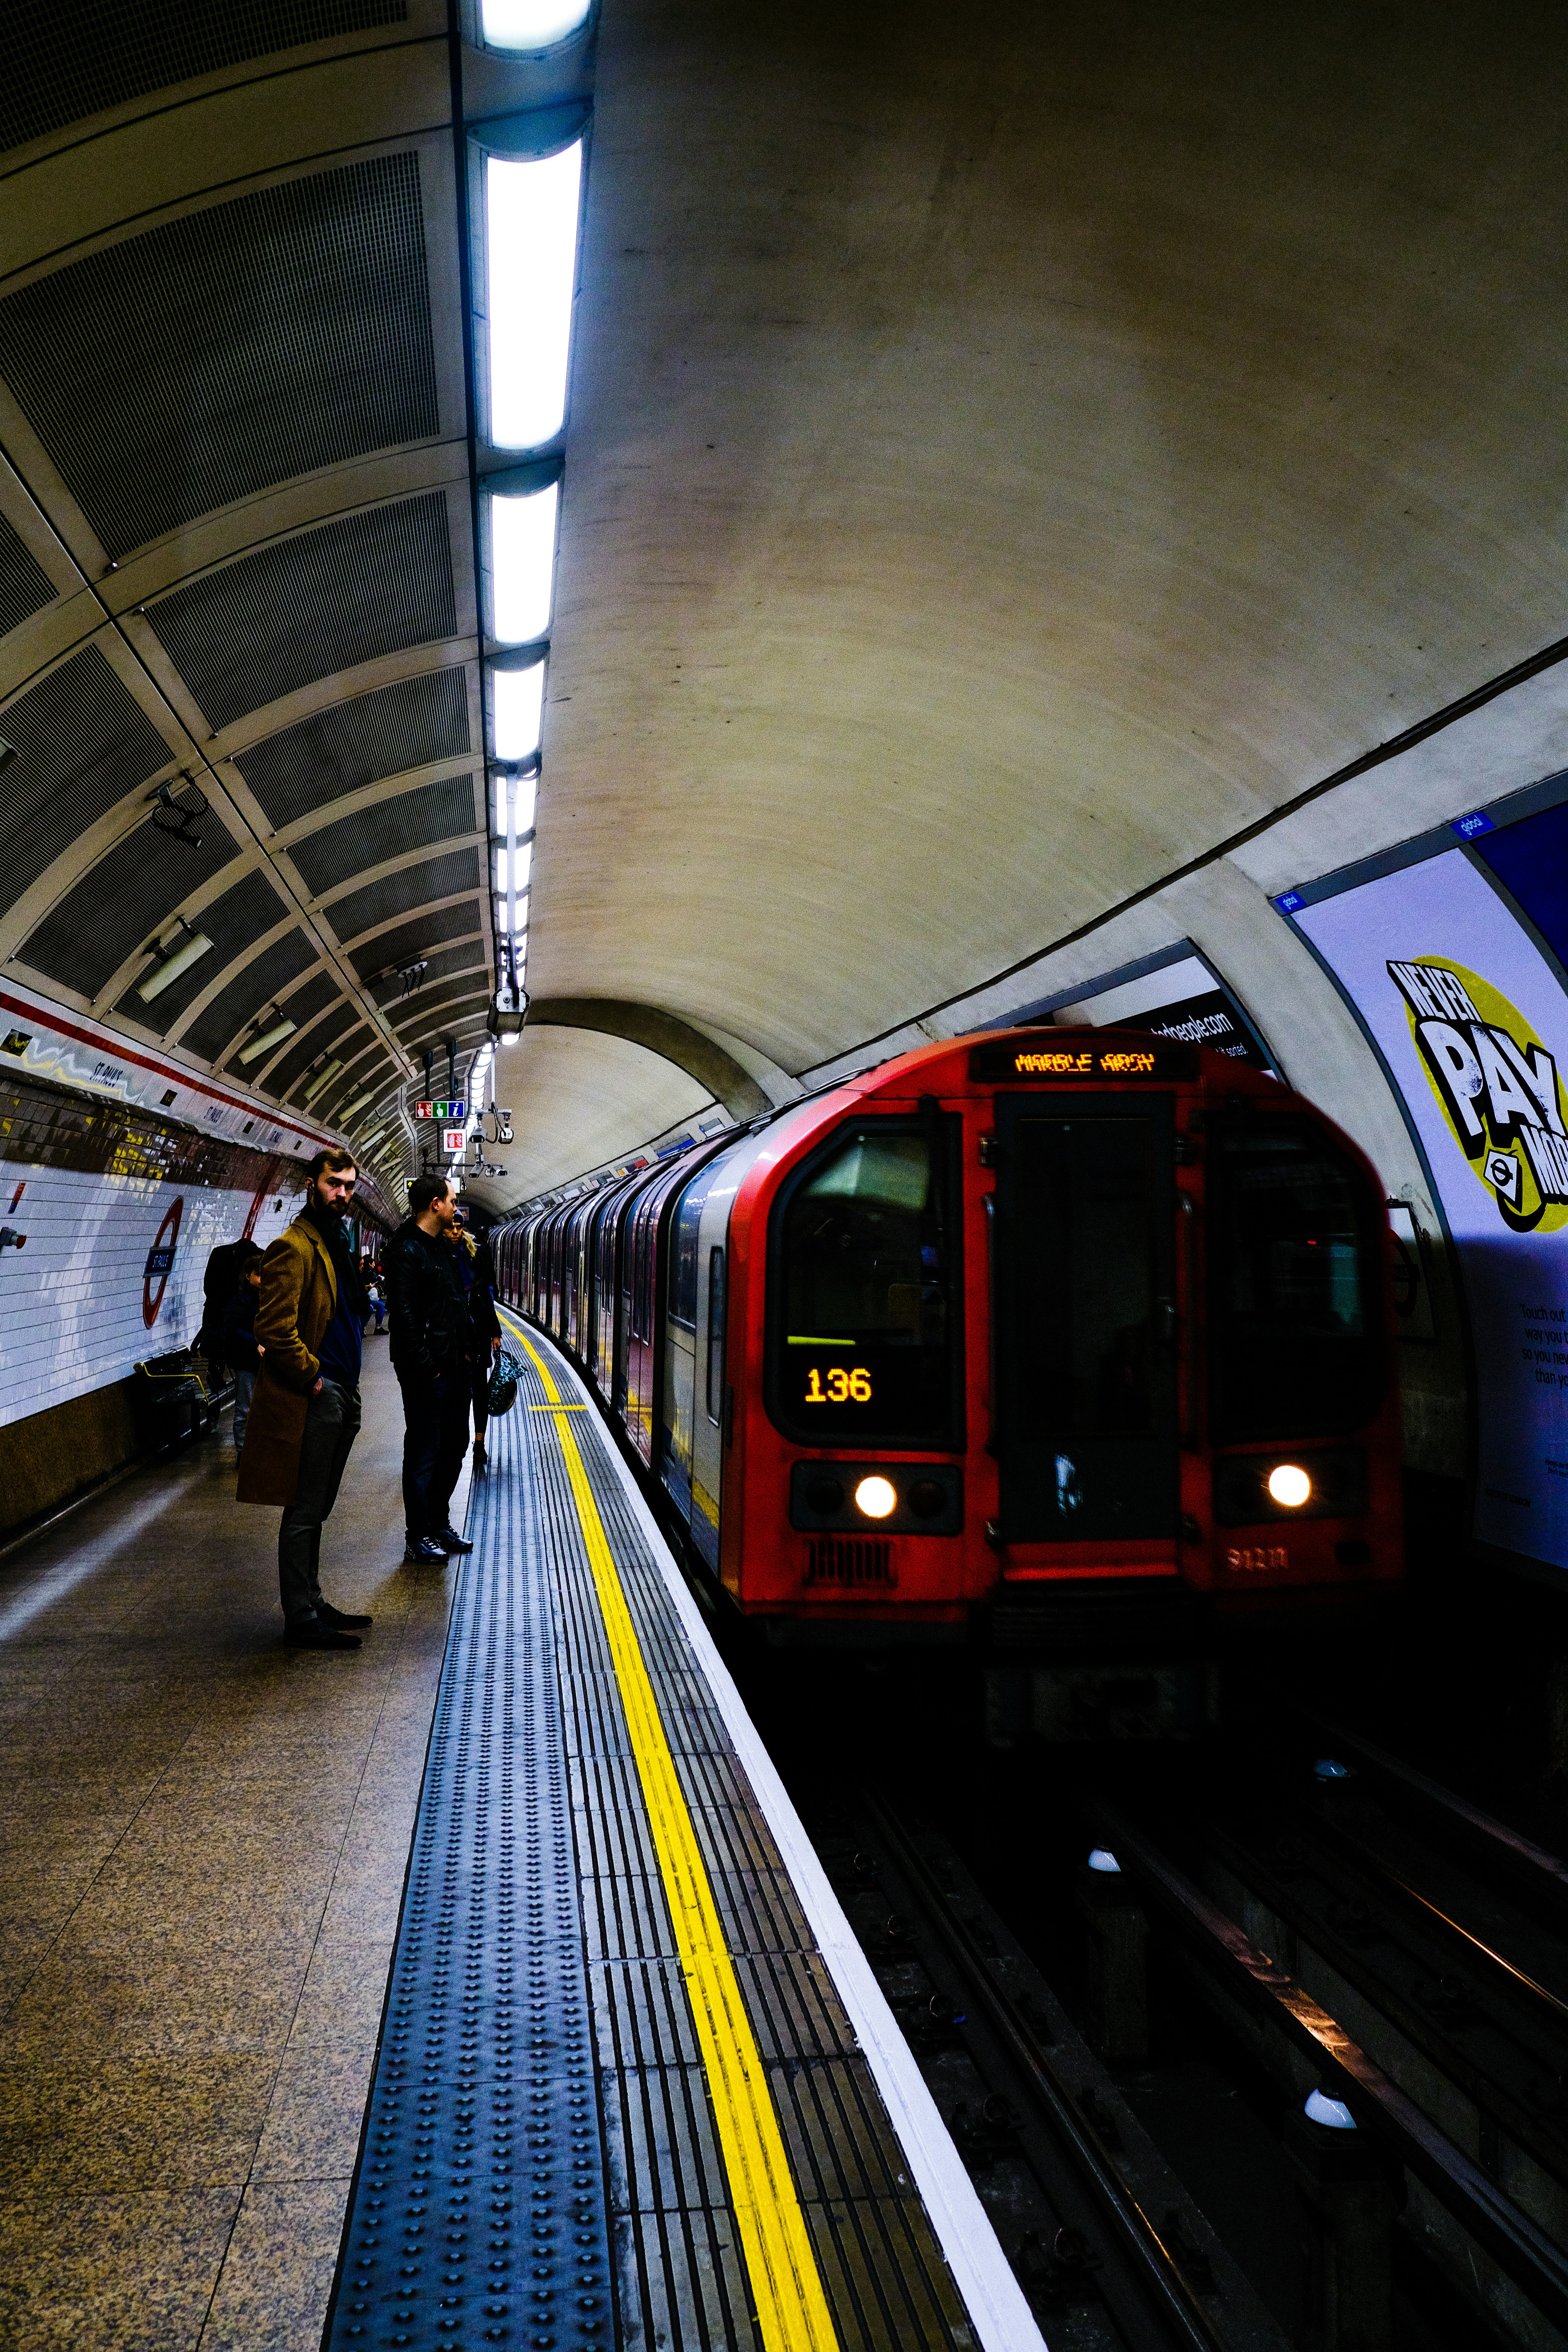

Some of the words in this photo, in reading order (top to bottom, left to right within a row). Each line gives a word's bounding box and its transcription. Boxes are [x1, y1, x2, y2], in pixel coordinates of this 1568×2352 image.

[1461, 815, 1483, 836] global
[1283, 894, 1298, 910] global
[1387, 962, 1483, 1023] NEVER
[1226, 1042, 1248, 1057] sorted.
[1015, 1054, 1092, 1072] MARBLE
[1100, 1054, 1155, 1071] ARCH
[1419, 1020, 1567, 1138] PAY
[1519, 1124, 1568, 1195] MOR
[1520, 1304, 1548, 1320] Touch
[1550, 1309, 1566, 1322] out
[1525, 1328, 1543, 1344] way
[1545, 1331, 1562, 1345] you
[1522, 1348, 1532, 1360] so
[1534, 1350, 1551, 1364] you
[1535, 1367, 1556, 1384] than
[804, 1368, 872, 1403] 136
[1510, 1494, 1530, 1508] LONDON
